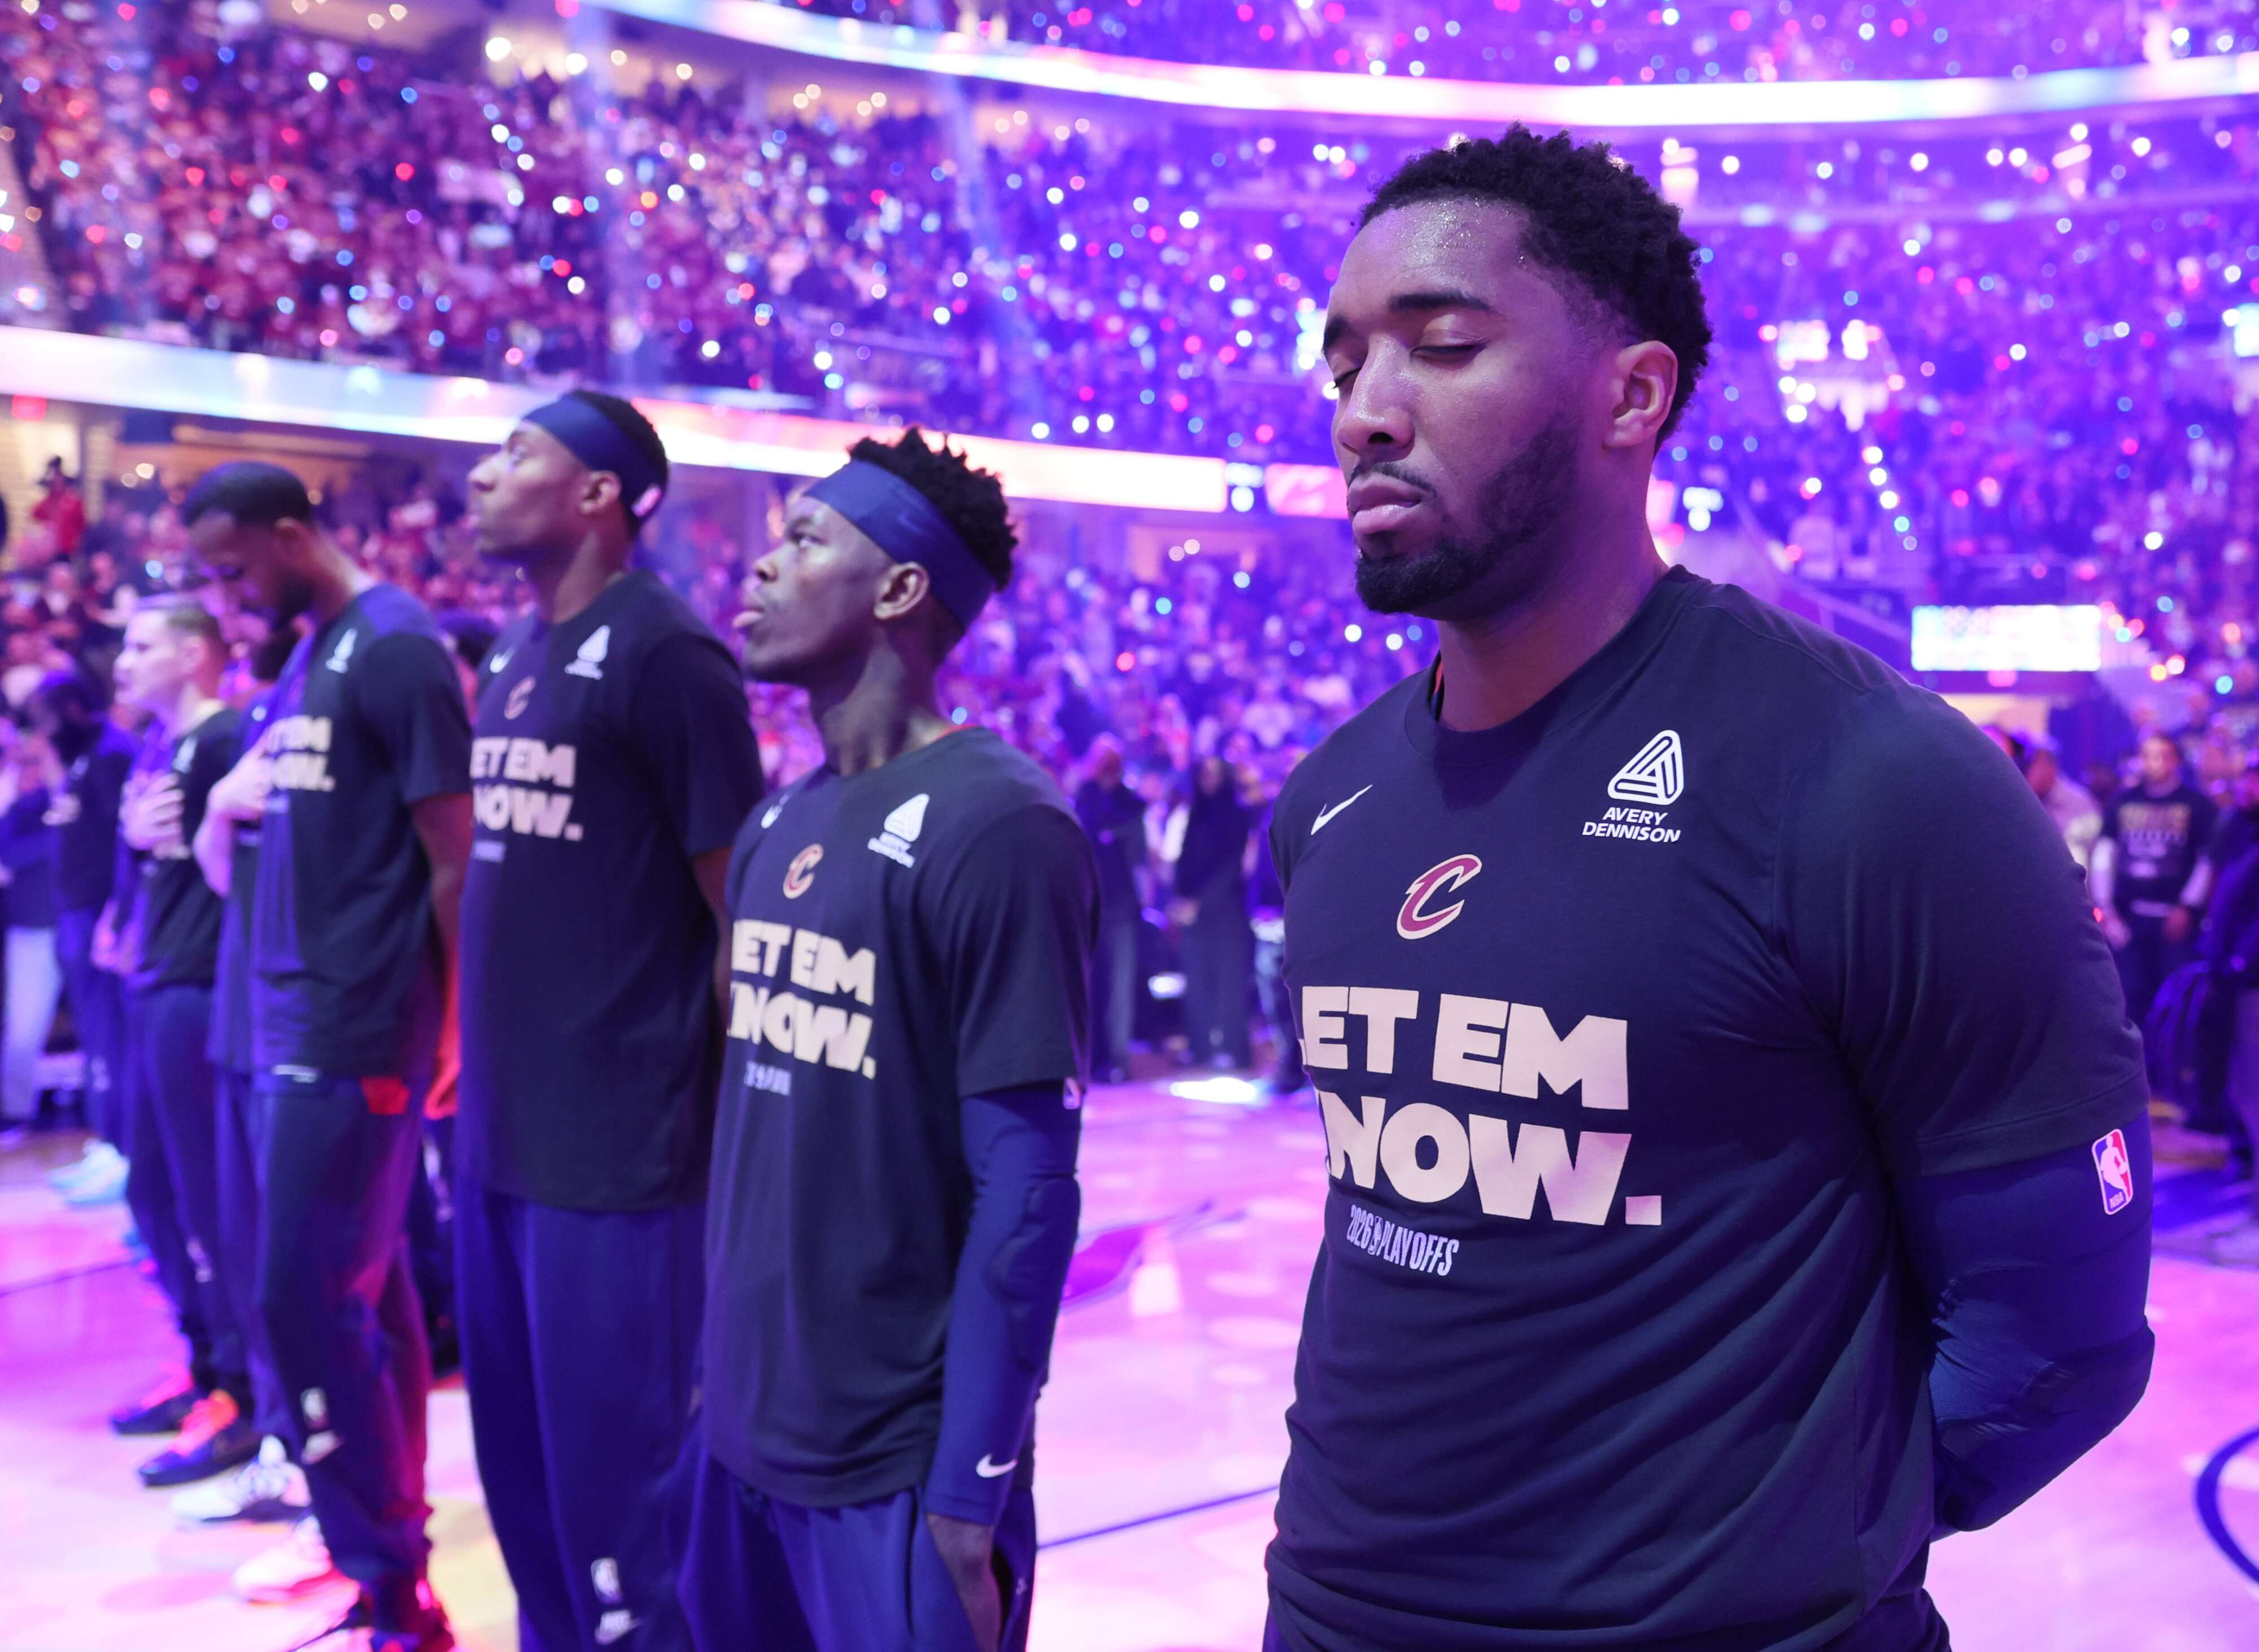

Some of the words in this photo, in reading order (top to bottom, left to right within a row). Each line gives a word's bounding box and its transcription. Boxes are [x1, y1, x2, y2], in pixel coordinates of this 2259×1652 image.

[470, 736, 509, 779] ET
[503, 736, 576, 788] EM
[1582, 821, 1681, 843] DENNISON
[1602, 807, 1668, 825] AVERY
[1397, 854, 1482, 939] C
[731, 919, 792, 977] ET
[790, 928, 876, 1007] EM
[726, 980, 876, 1080] NOW.
[1298, 986, 1420, 1074] ET
[1432, 993, 1629, 1110] EM
[1314, 1090, 1662, 1226] NOW.
[2109, 1191, 2123, 1209] NBA
[1346, 1204, 1374, 1249] 2026
[1376, 1221, 1460, 1277] PLAYOFFS
